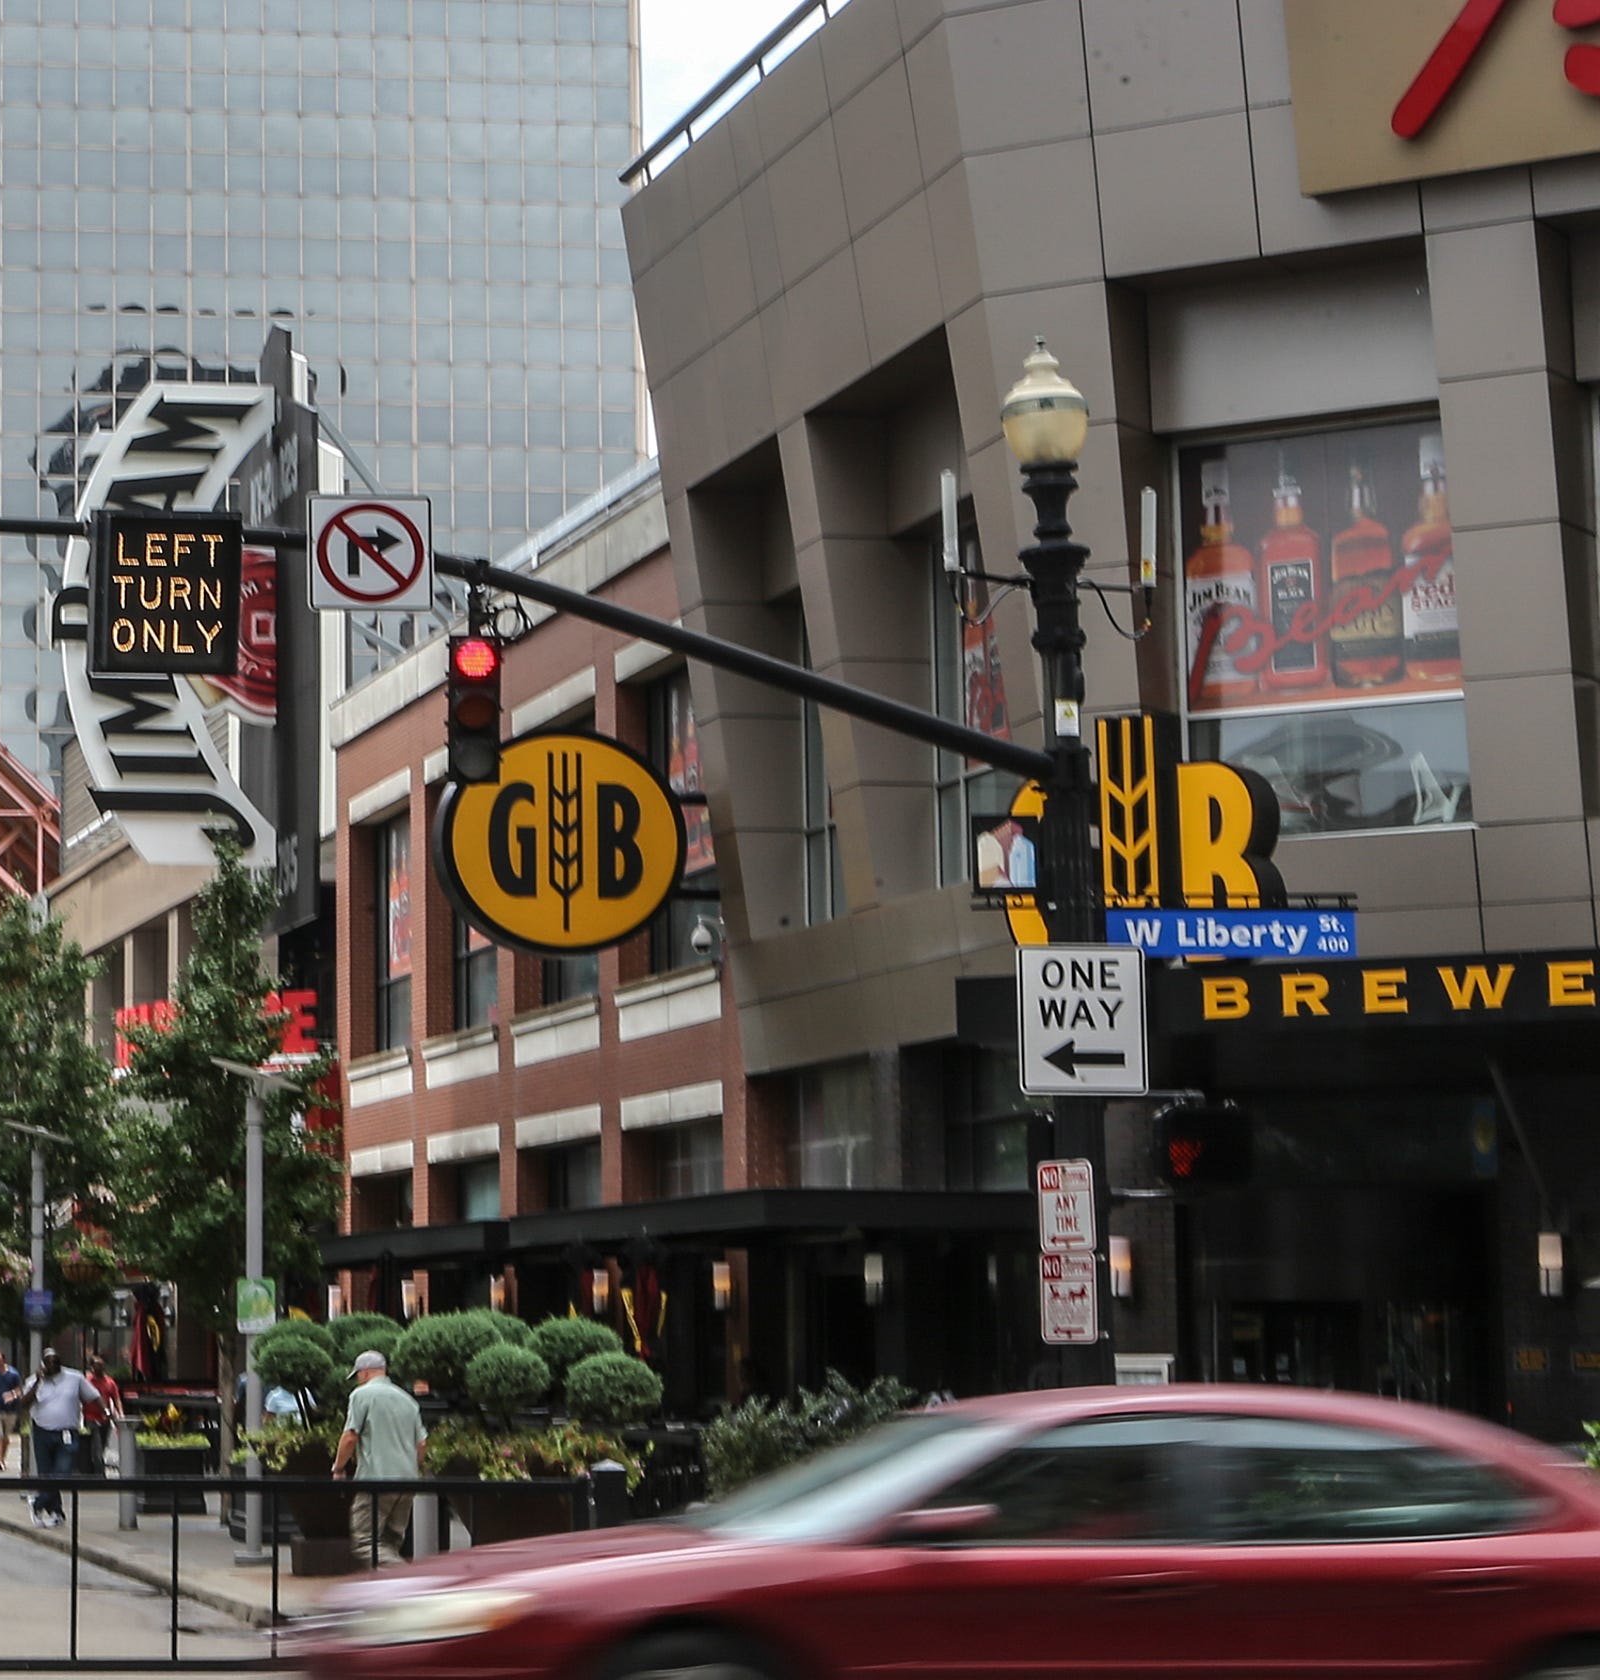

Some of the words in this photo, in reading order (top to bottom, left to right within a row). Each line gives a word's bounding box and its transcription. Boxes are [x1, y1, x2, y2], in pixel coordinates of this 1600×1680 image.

[116, 532, 224, 567] LEFT
[112, 576, 222, 611] TURN
[1187, 586, 1213, 613] JIM
[112, 620, 224, 655] ONLY
[88, 674, 257, 848] JIM
[1124, 918, 1162, 948] W
[1176, 917, 1308, 955] Liberty
[1317, 914, 1346, 934] St.
[1316, 936, 1349, 953] 400
[1041, 959, 1122, 991] ONE
[1039, 997, 1124, 1030] WAY
[1042, 1167, 1060, 1189] NO
[1055, 1193, 1079, 1212] ANY
[1056, 1215, 1081, 1233] TIME
[1043, 1256, 1062, 1278] NO
